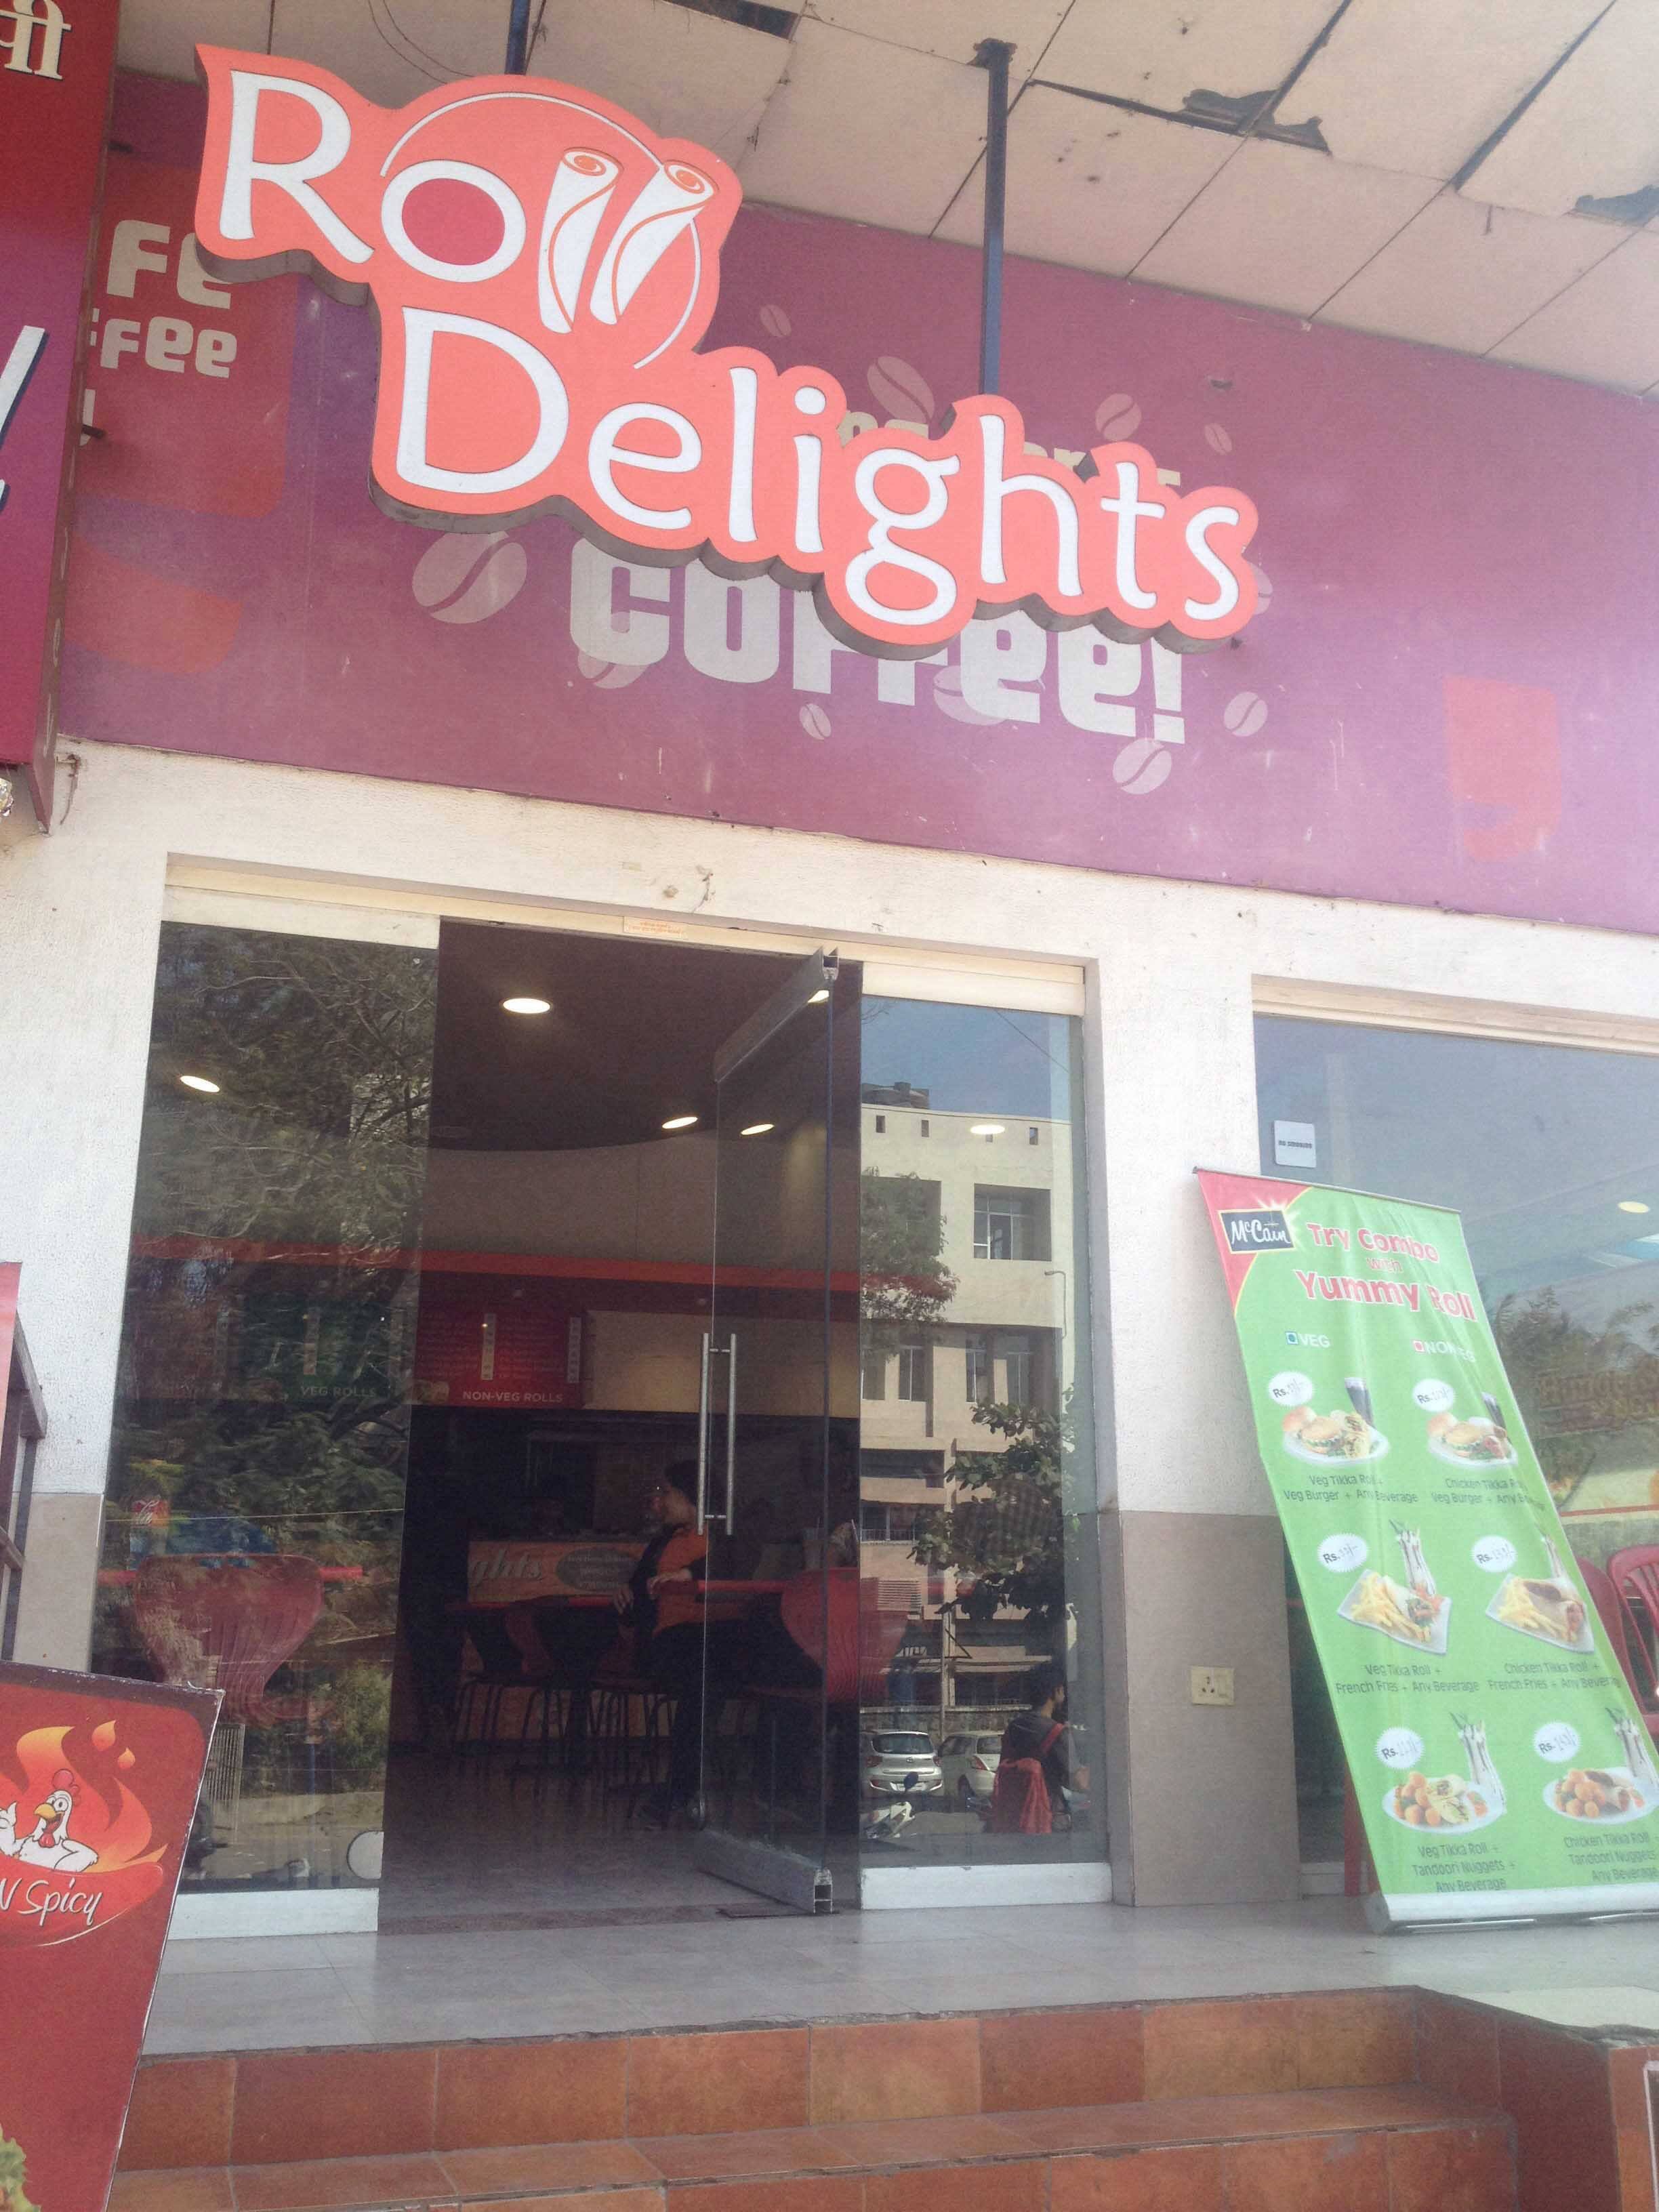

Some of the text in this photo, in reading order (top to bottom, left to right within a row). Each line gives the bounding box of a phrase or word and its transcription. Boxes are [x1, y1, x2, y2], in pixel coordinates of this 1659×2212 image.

[396, 305, 1241, 626] Delights
[1231, 1218, 1291, 1244] McCain
[1307, 1222, 1439, 1263] Try Combo
[1295, 1269, 1478, 1322] Yummy Roll
[1298, 1333, 1331, 1349] VEG
[463, 1391, 564, 1403] NON-VEG ROLLS
[1309, 1475, 1329, 1487] Veg
[1330, 1475, 1357, 1486] Tikka
[1284, 1490, 1304, 1502] Veg
[1306, 1490, 1340, 1503] Burger
[1376, 1490, 1418, 1504] Beverage
[1364, 1663, 1387, 1677] Veg
[1412, 1664, 1432, 1676] Roll
[1504, 1662, 1542, 1675] Chicken
[1569, 1660, 1589, 1673] Roll
[1335, 1681, 1374, 1694] French
[1375, 1680, 1399, 1692] Fries
[1412, 1681, 1432, 1694] Any
[1432, 1681, 1480, 1694] Beverage
[1418, 1845, 1440, 1860] Veg
[1440, 1843, 1468, 1857] Tikka
[1468, 1842, 1488, 1855] Roll
[1411, 1862, 1460, 1877] Tandoori
[1460, 1859, 1506, 1875] Nuggets
[1435, 1878, 1508, 1893] Any Beverage
[17, 1877, 103, 1927] Spicy
